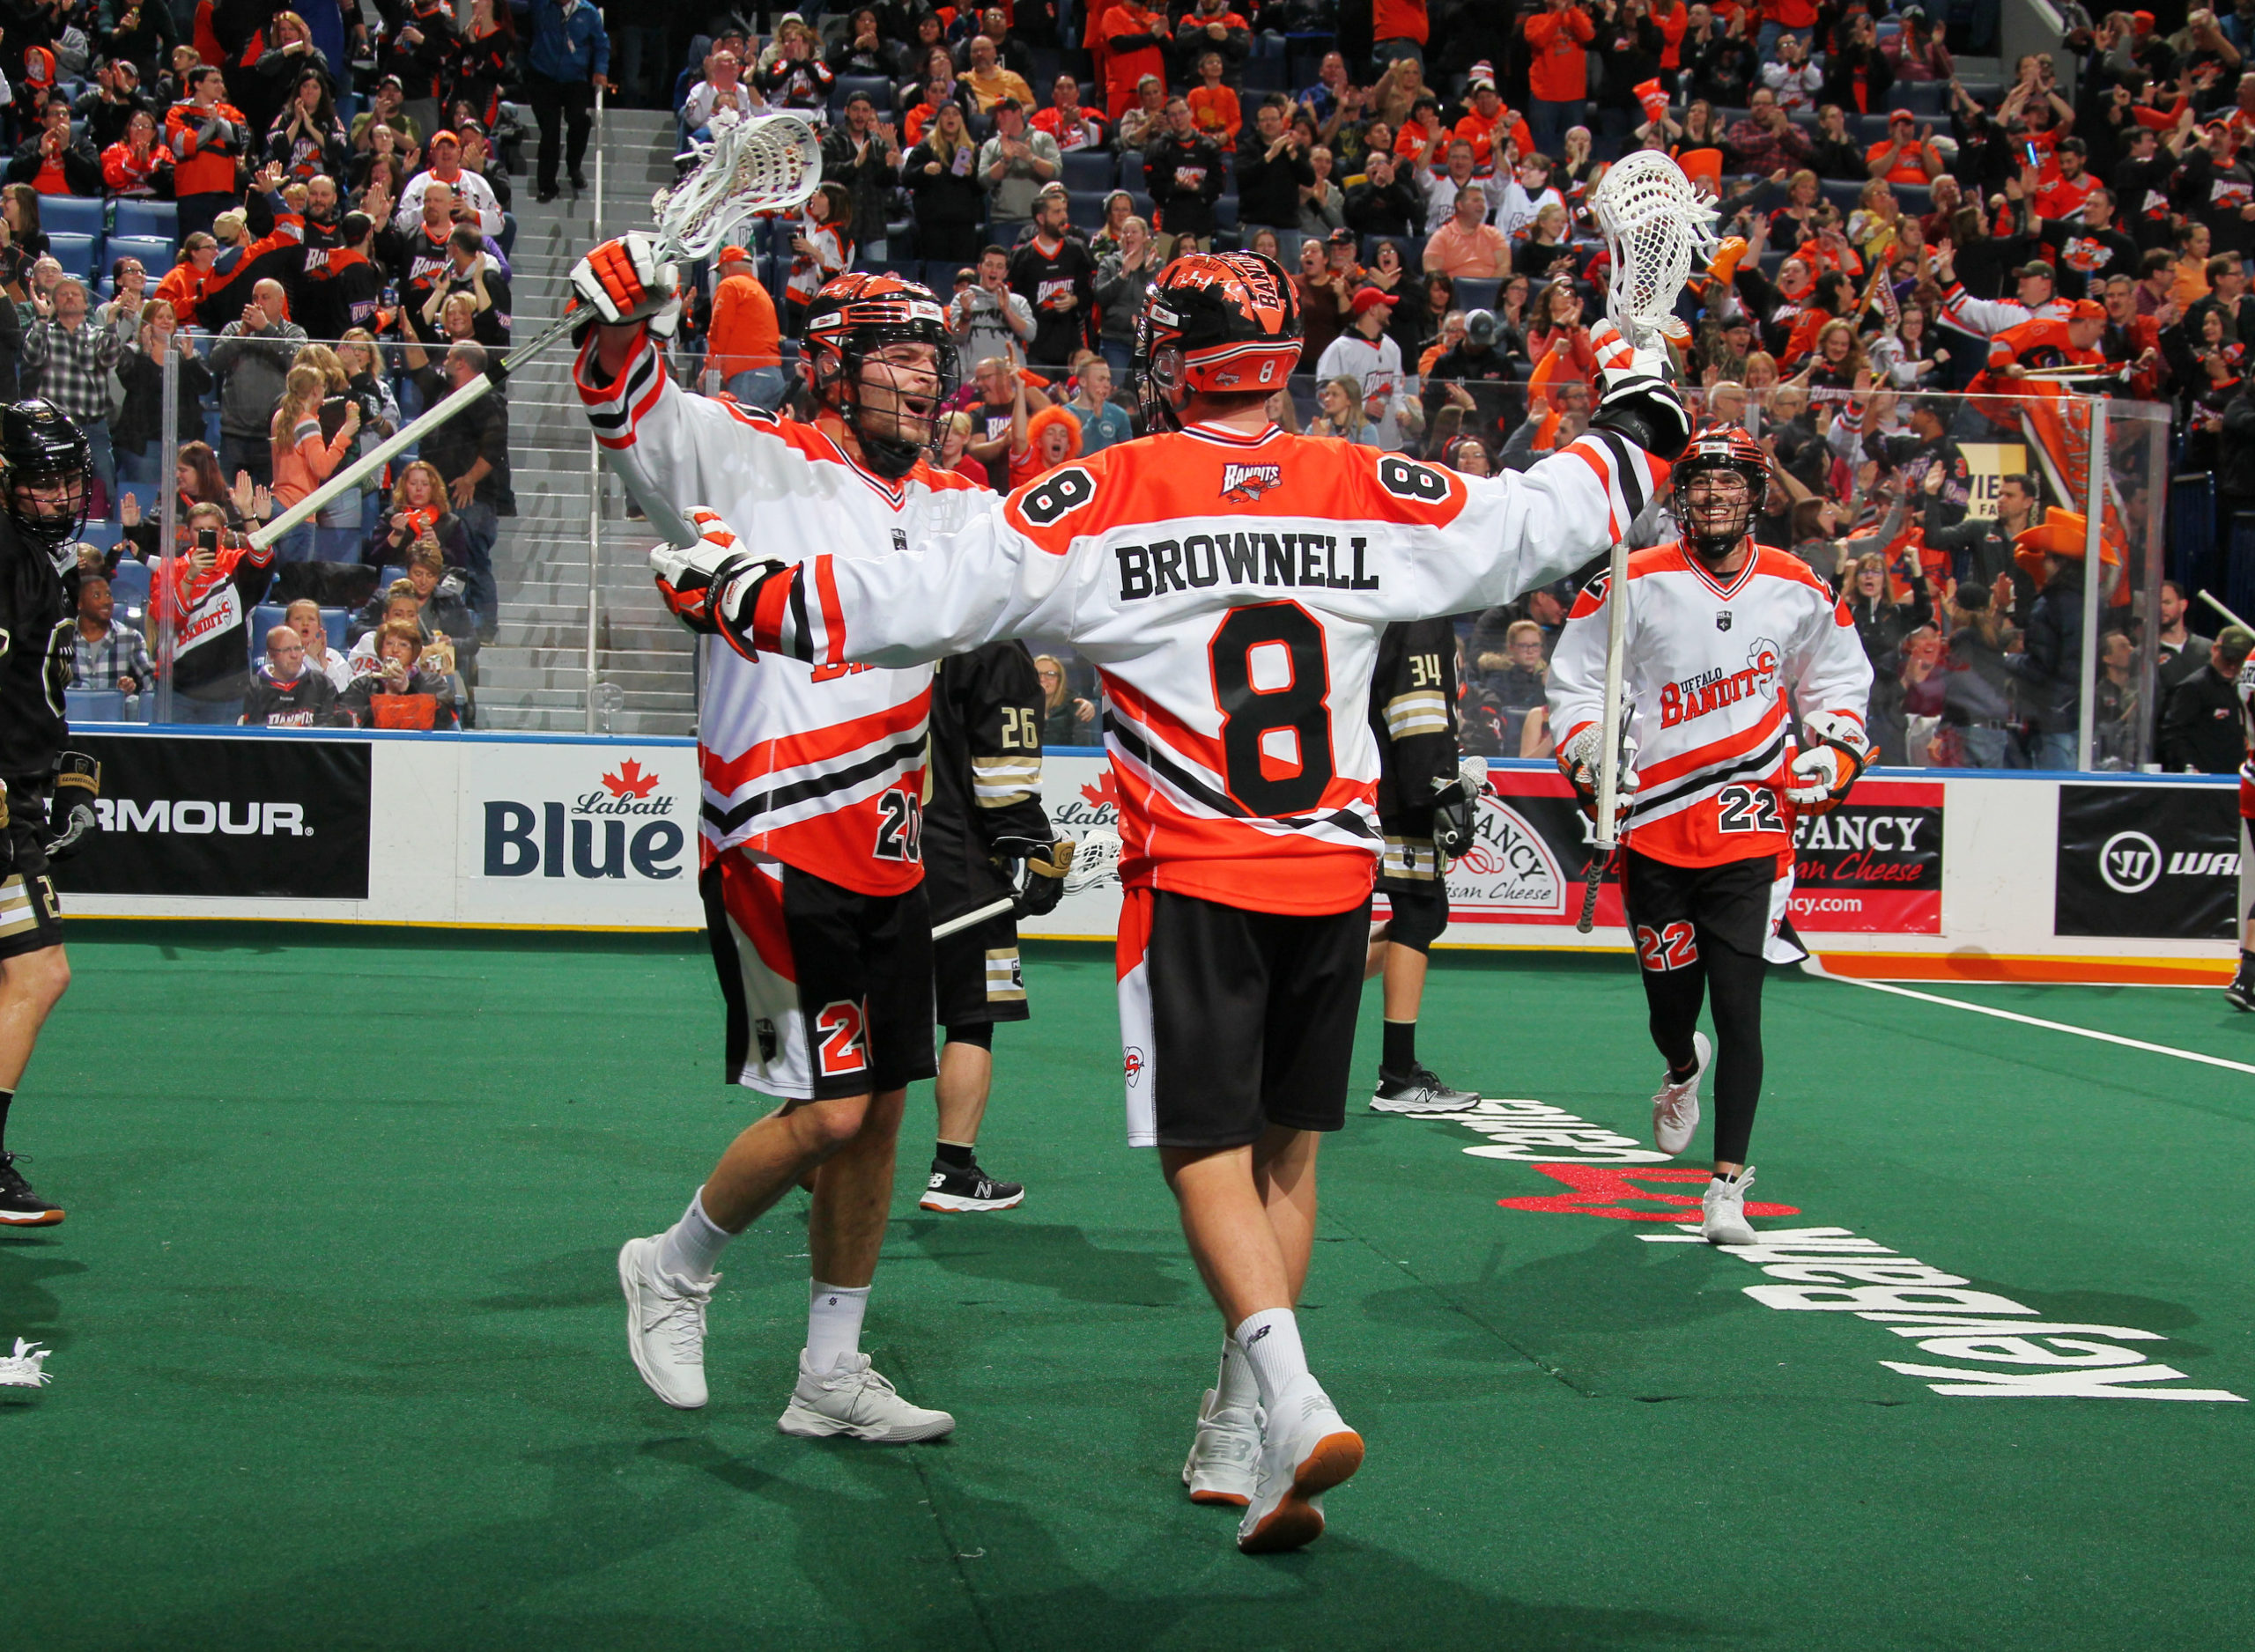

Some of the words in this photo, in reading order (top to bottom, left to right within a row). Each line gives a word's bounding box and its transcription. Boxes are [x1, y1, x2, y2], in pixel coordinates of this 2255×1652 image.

[1258, 359, 1275, 384] 8
[1017, 467, 1098, 527] 8
[1220, 462, 1281, 495] BANDITS
[1377, 455, 1452, 505] 8
[1115, 532, 1380, 601] BROWNELL
[1409, 654, 1442, 688] 34
[1660, 650, 1776, 731] BANDITS
[1002, 706, 1039, 749] 26
[1207, 599, 1338, 820] 8
[43, 796, 305, 836] RMOUR
[572, 791, 674, 815] Labatt
[872, 788, 923, 864] 20
[1718, 785, 1786, 834] 22
[483, 800, 684, 880] Blue
[1474, 807, 1547, 881] ANCY
[1793, 815, 1924, 852] FANCY
[1831, 844, 1923, 881] Cheese
[1445, 881, 1482, 898] isan
[1490, 881, 1552, 900] Cheese
[1636, 919, 1699, 972] 22
[816, 993, 874, 1077] 2
[1634, 1223, 2248, 1402] KeyBank
